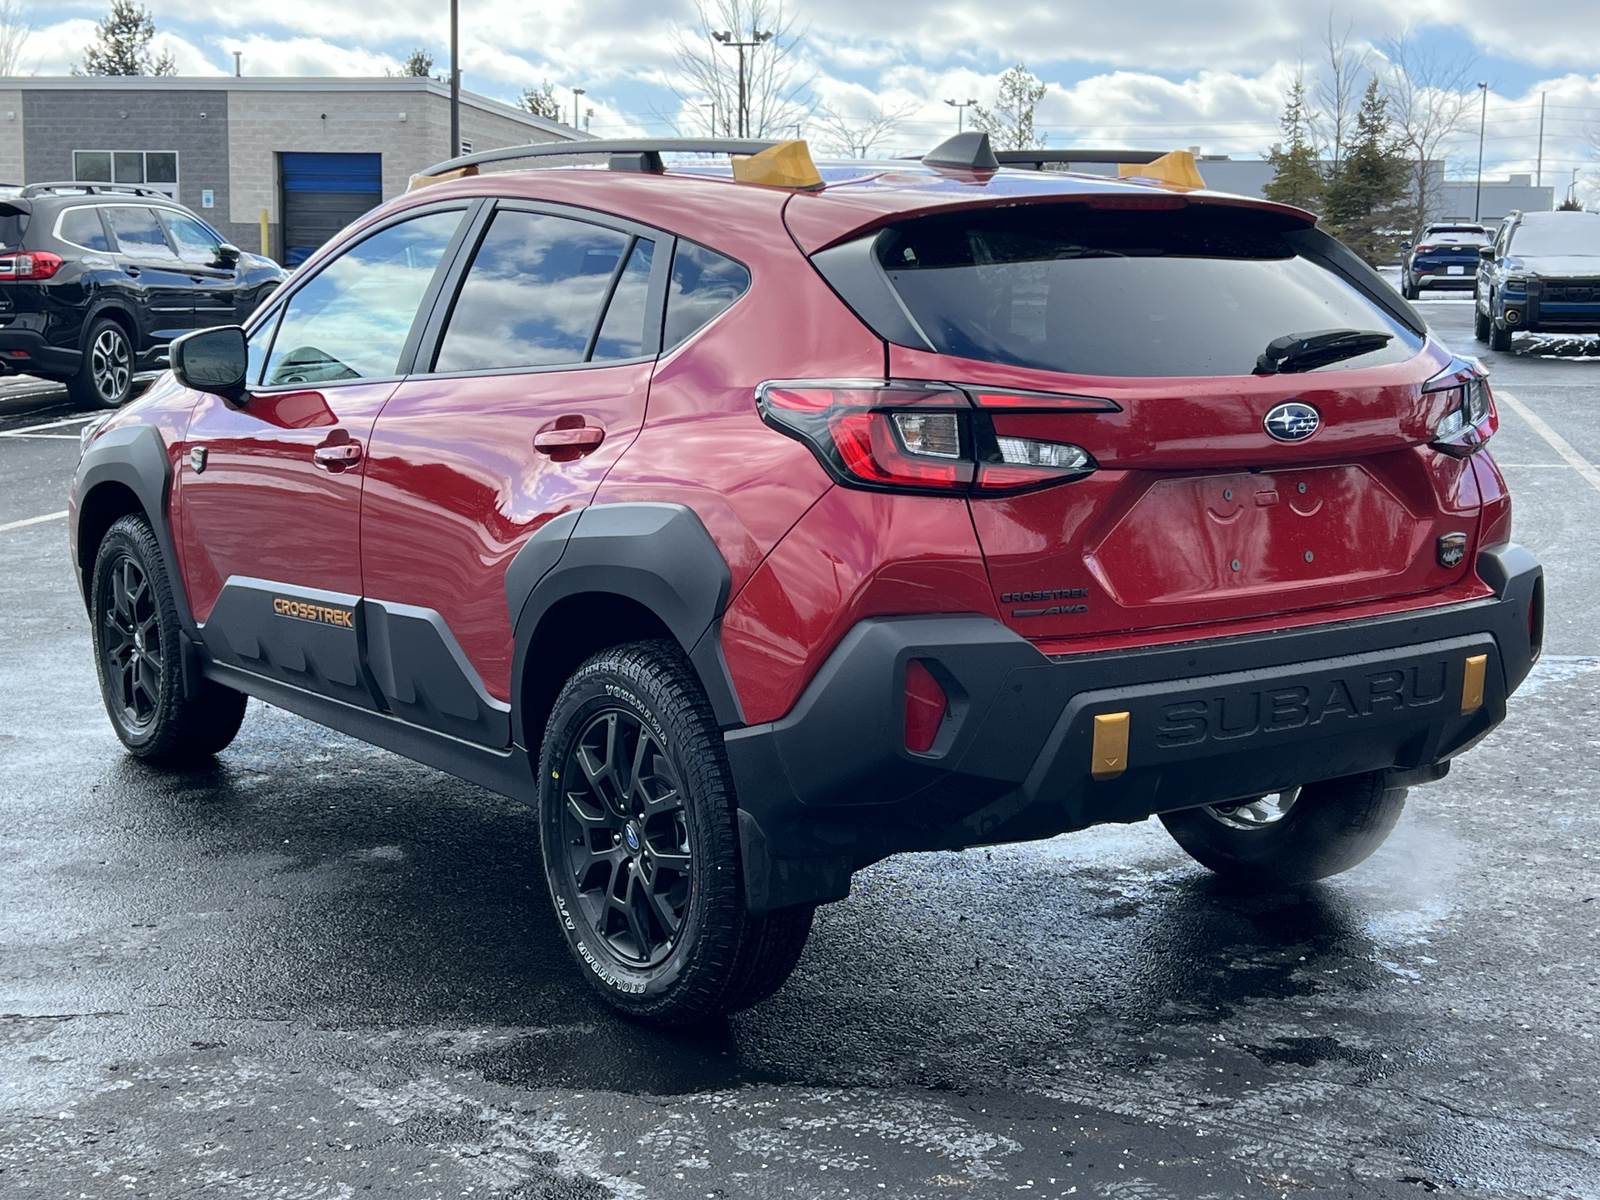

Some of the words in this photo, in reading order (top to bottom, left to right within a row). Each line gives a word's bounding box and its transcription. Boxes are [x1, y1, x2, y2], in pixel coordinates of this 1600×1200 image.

[1001, 588, 1088, 603] CROSSTREK
[1042, 604, 1088, 616] AWD
[273, 598, 354, 628] CROSSTREK
[605, 684, 668, 746] YOKOHAMA
[1156, 661, 1446, 748] SUBARU
